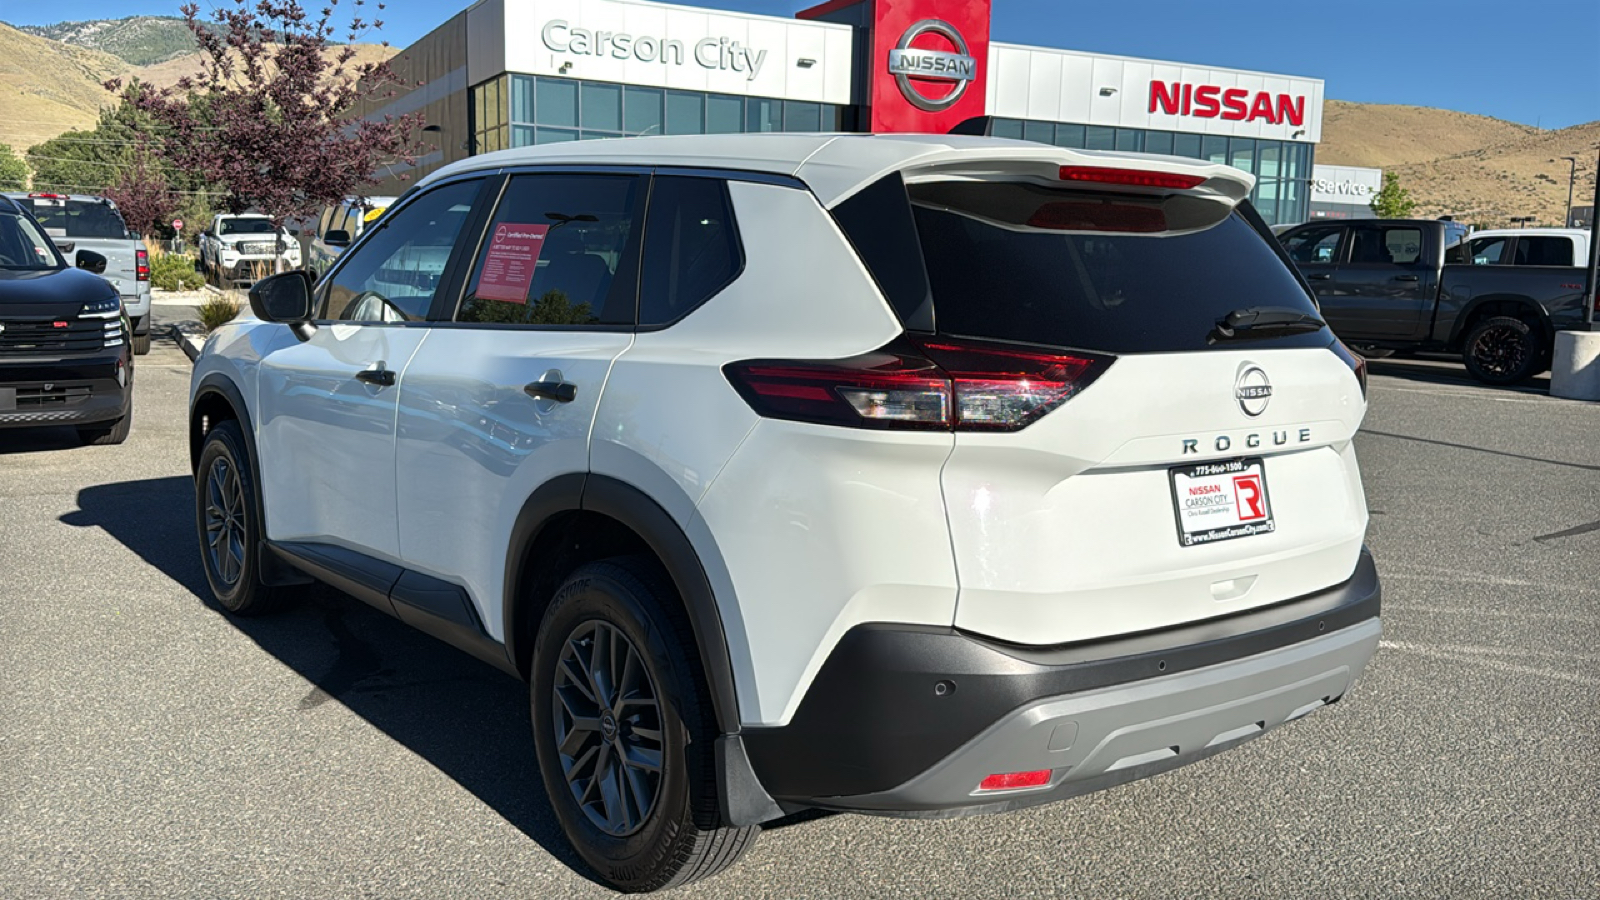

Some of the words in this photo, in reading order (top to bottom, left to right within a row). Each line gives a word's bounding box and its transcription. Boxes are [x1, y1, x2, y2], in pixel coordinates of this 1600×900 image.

[541, 19, 684, 65] Carson
[694, 36, 768, 81] City
[900, 54, 970, 76] NISSAN
[1148, 79, 1305, 126] NISSAN
[1316, 178, 1366, 196] Service
[1239, 386, 1272, 397] NISSAN
[1182, 428, 1310, 454] ROGUE
[1189, 484, 1221, 496] NISSAN
[1185, 495, 1213, 508] CARSON
[1214, 494, 1228, 506] CITY
